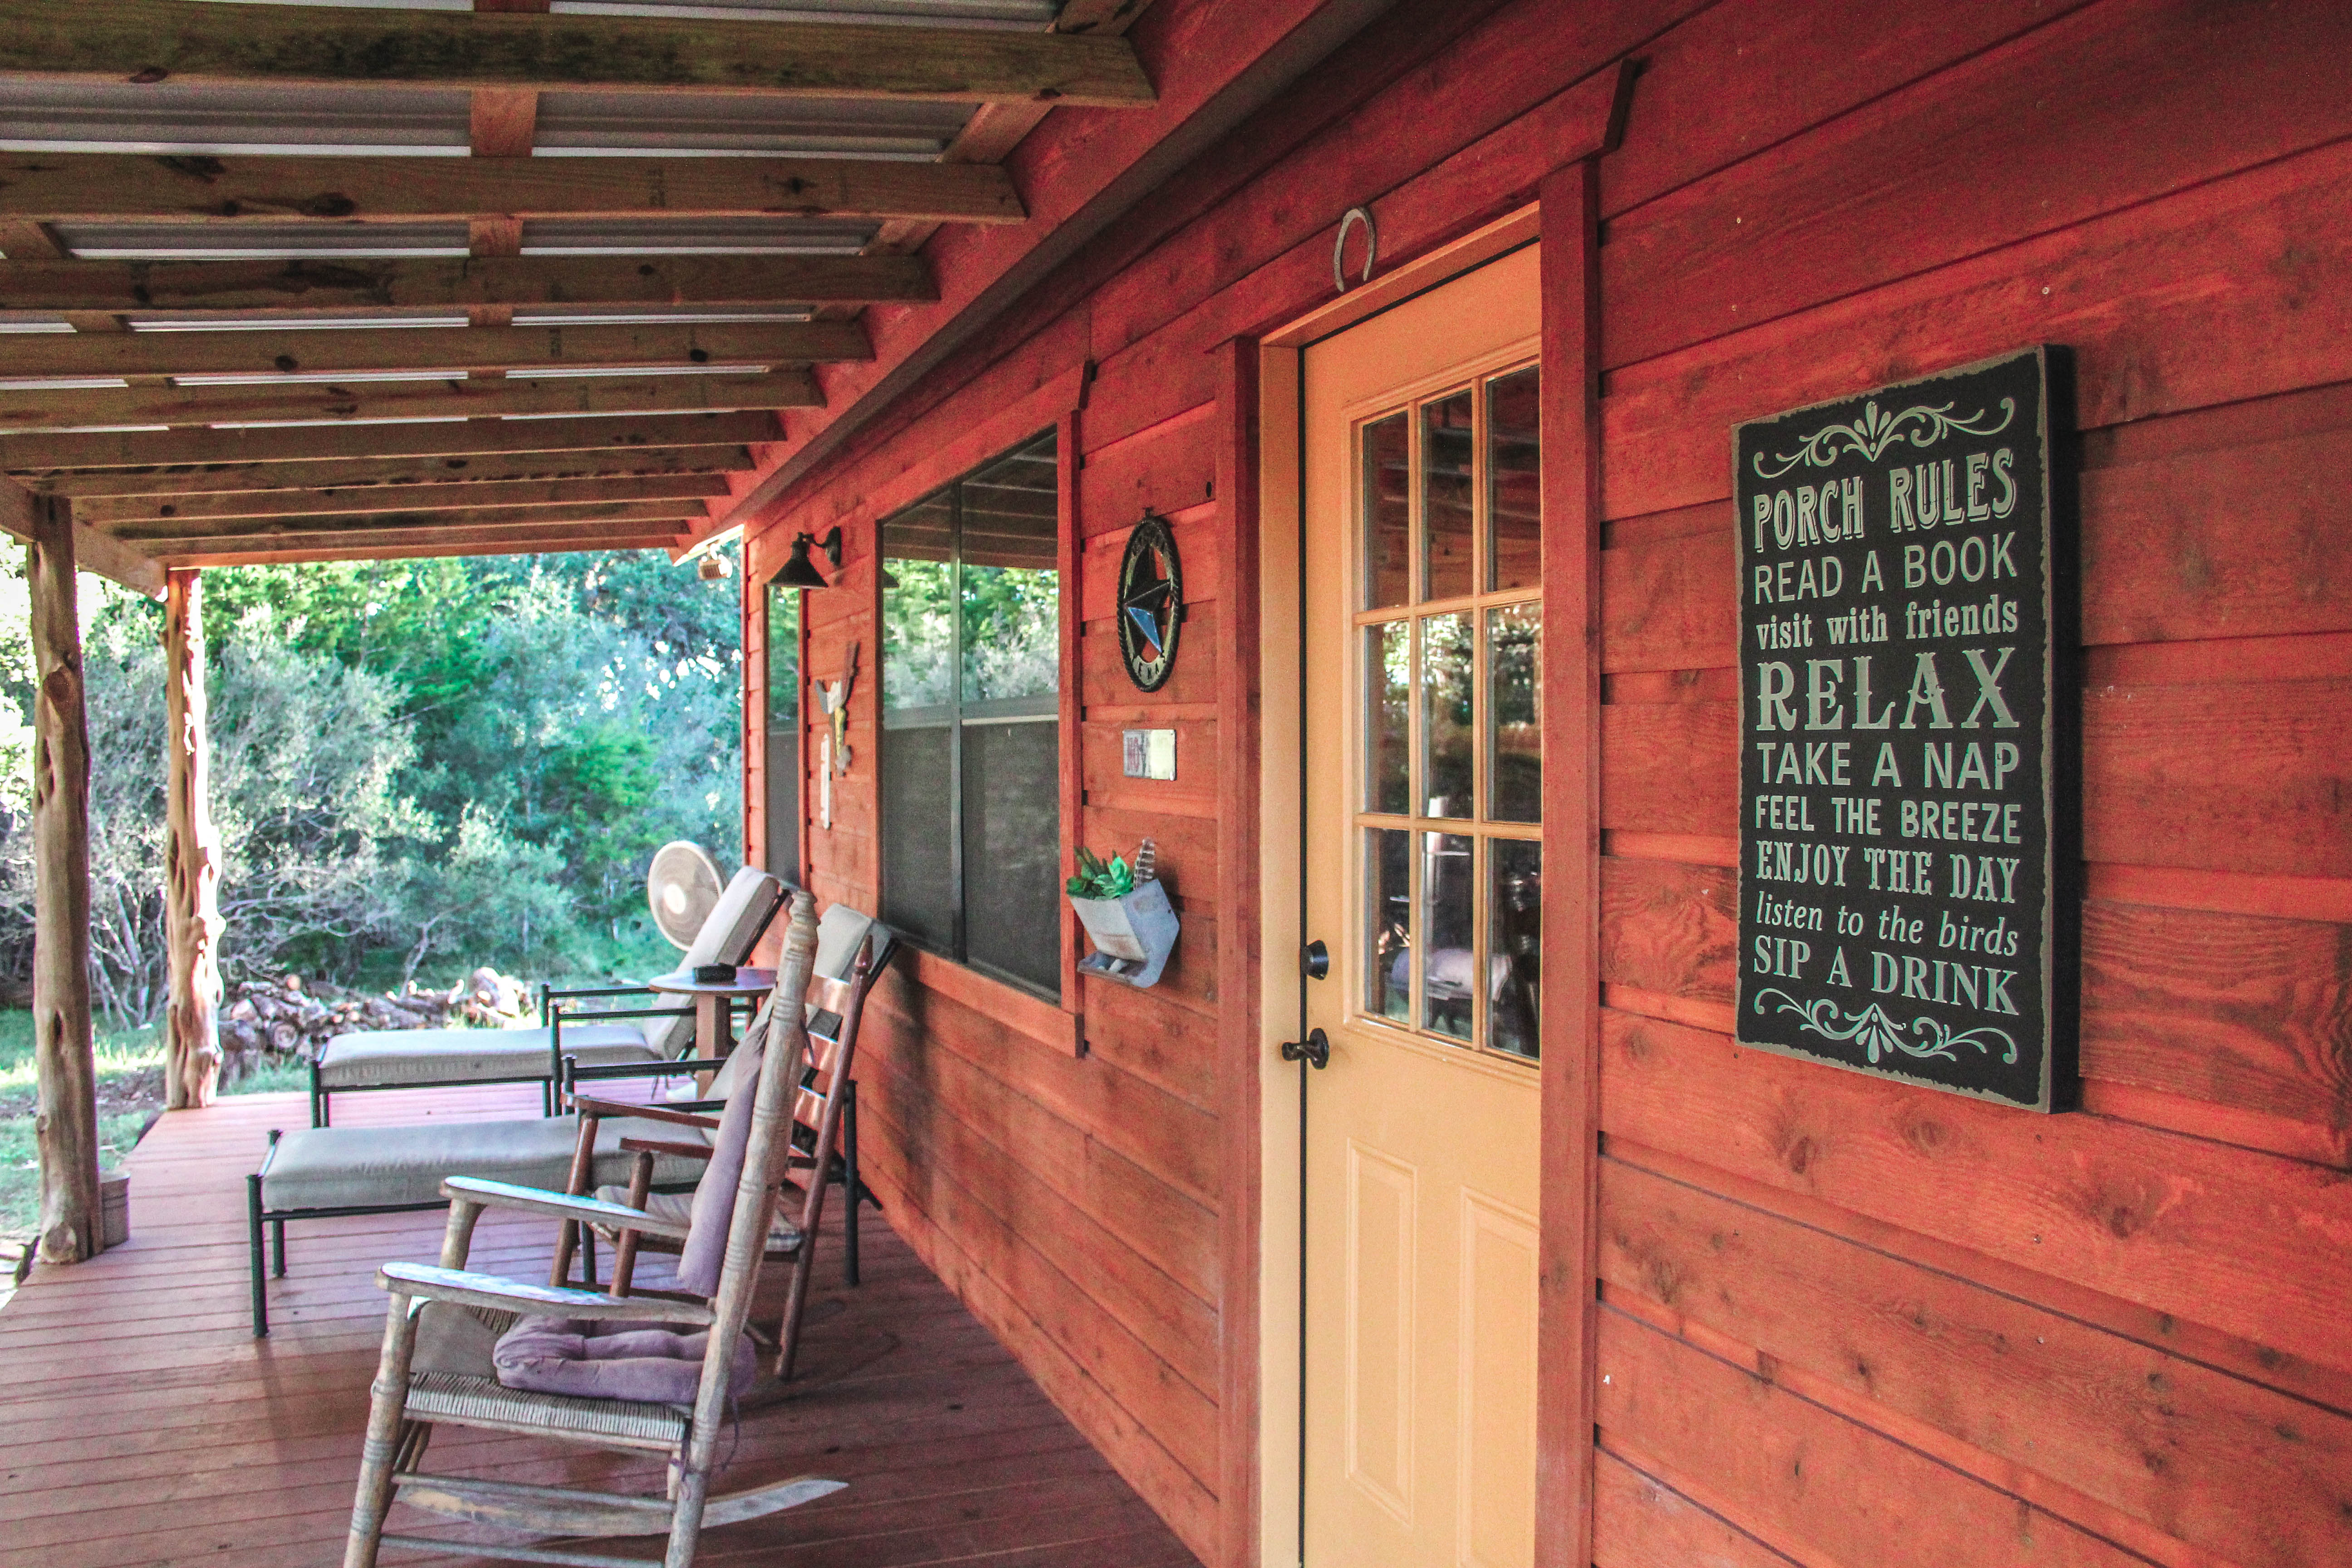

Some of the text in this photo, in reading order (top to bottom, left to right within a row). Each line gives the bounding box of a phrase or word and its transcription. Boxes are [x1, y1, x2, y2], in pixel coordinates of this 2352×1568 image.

[1754, 448, 2016, 553] PORCH RULES
[1755, 531, 2017, 604] READ A BOOK
[1756, 594, 2018, 650] visit with friends
[1756, 647, 2019, 731] RELAX
[1756, 742, 2019, 790] TAKE A NAP
[1755, 795, 2021, 844] FEEL THE BREEZE
[1756, 840, 2020, 903] ENJOY THE DAY
[1756, 891, 2018, 956] listen to the birds
[1754, 935, 2019, 1015] SIP A DRINK
